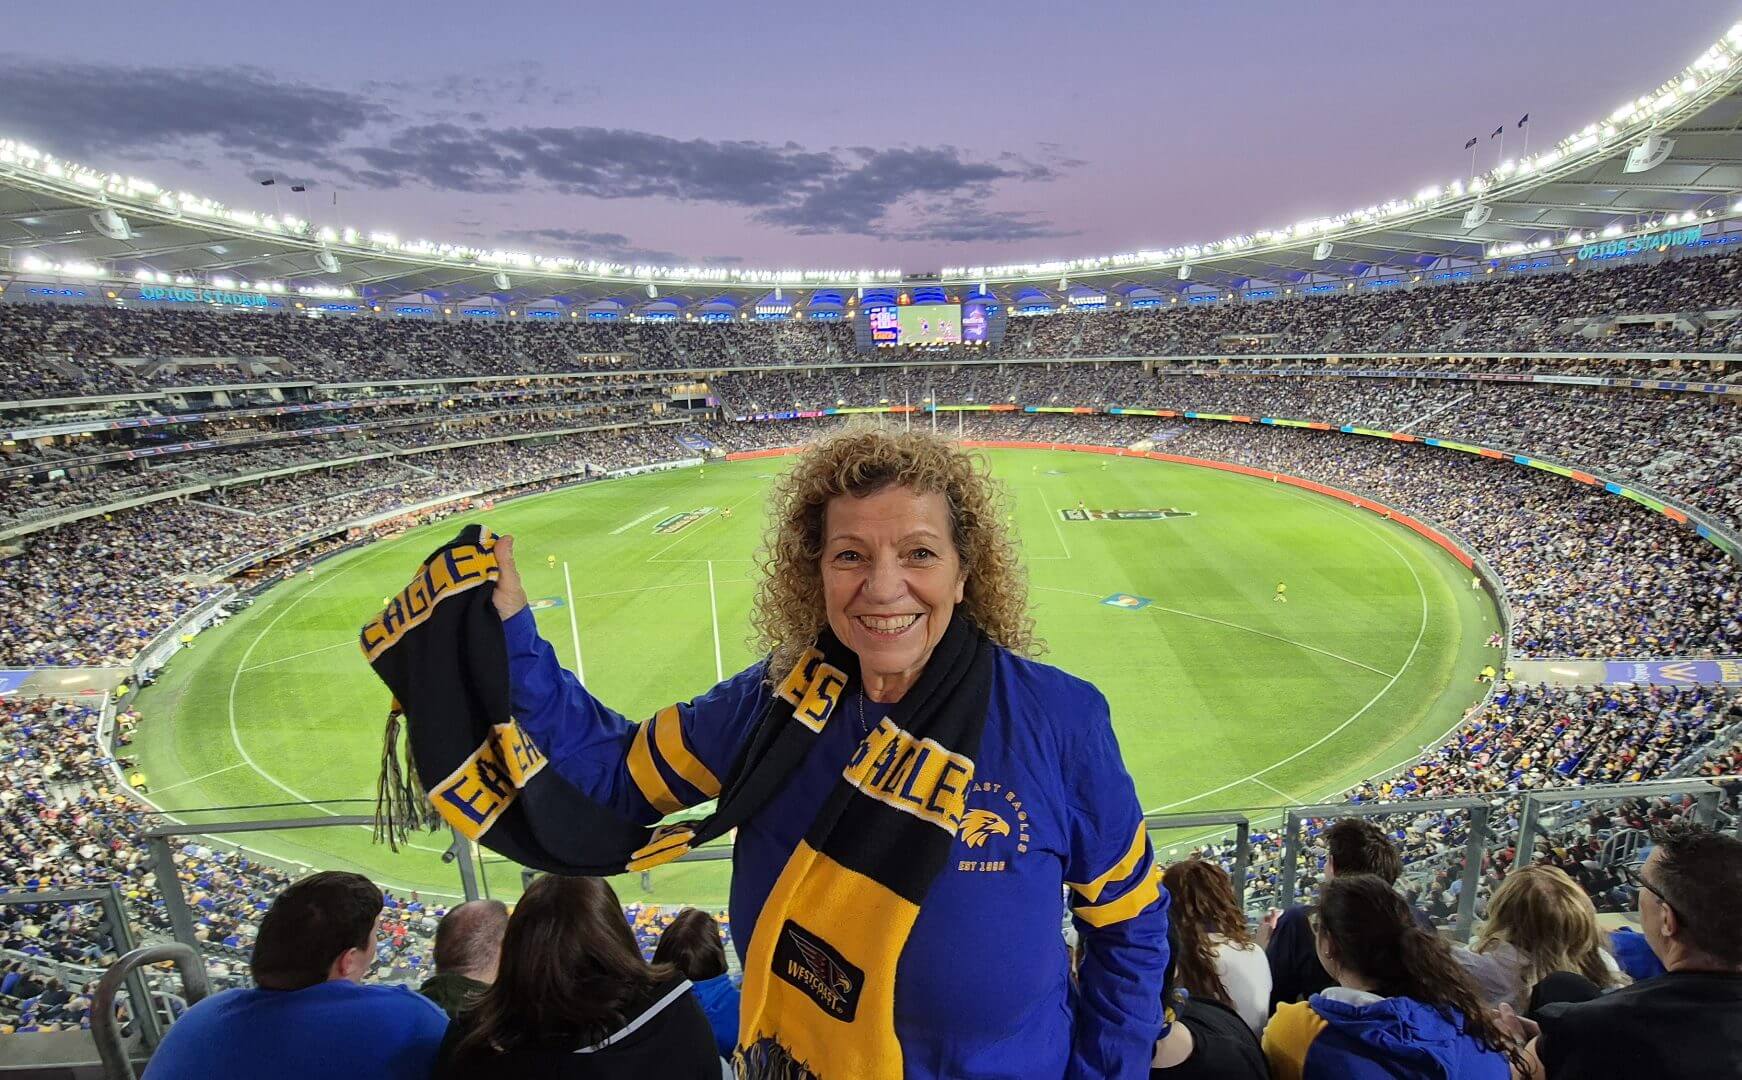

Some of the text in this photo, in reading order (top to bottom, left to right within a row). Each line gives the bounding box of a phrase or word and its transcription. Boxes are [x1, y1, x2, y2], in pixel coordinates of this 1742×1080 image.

[1578, 228, 1703, 260] OPTUS STADIUM
[140, 287, 269, 307] OPTUS STADIUM
[972, 782, 1030, 853] AST EAGLES
[958, 861, 977, 871] EST
